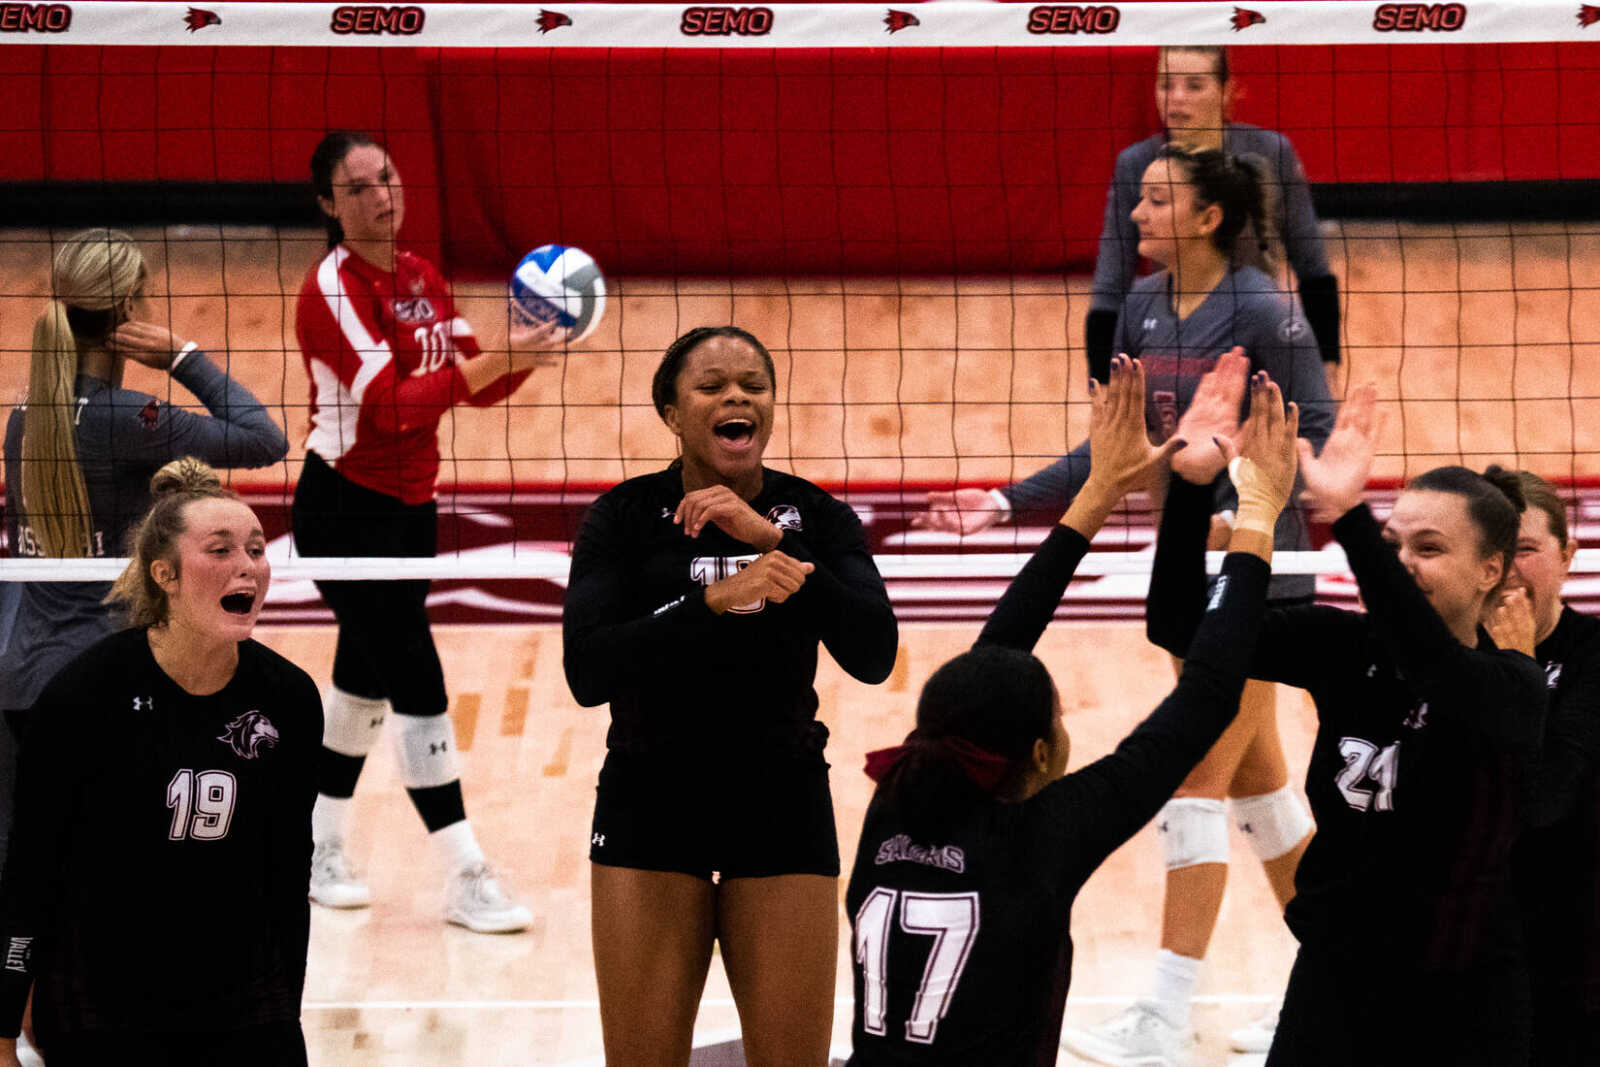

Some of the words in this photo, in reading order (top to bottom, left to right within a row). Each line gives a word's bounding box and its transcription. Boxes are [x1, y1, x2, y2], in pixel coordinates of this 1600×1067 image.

[0, 3, 72, 32] EMO
[330, 6, 425, 35] SEMO
[680, 7, 774, 36] SEMO
[1027, 6, 1120, 34] SEMO
[1373, 3, 1467, 31] SEMO
[1334, 737, 1400, 812] 21
[166, 768, 237, 840] 19
[5, 937, 34, 973] VALLEY
[855, 886, 980, 1044] 17
